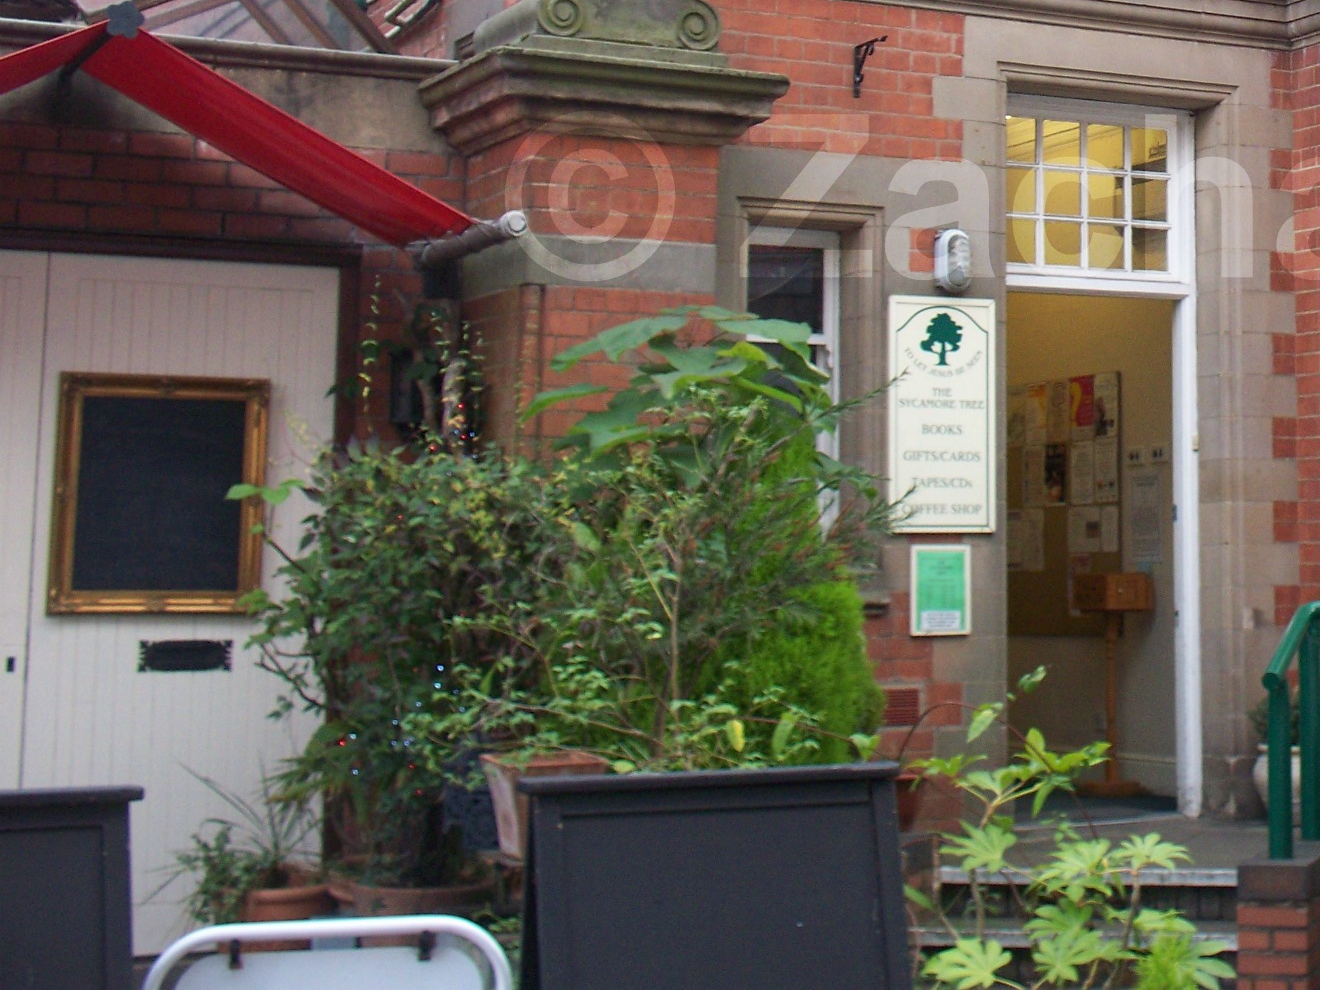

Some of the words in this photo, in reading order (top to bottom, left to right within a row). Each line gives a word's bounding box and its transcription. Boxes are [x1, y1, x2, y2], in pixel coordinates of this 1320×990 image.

[932, 387, 952, 398] THE
[899, 398, 956, 410] SYCAMORE
[959, 400, 985, 410] TREE
[921, 424, 963, 436] BOOKS
[903, 450, 981, 463] GIFTS/CARDS
[951, 504, 982, 516] SHOP
